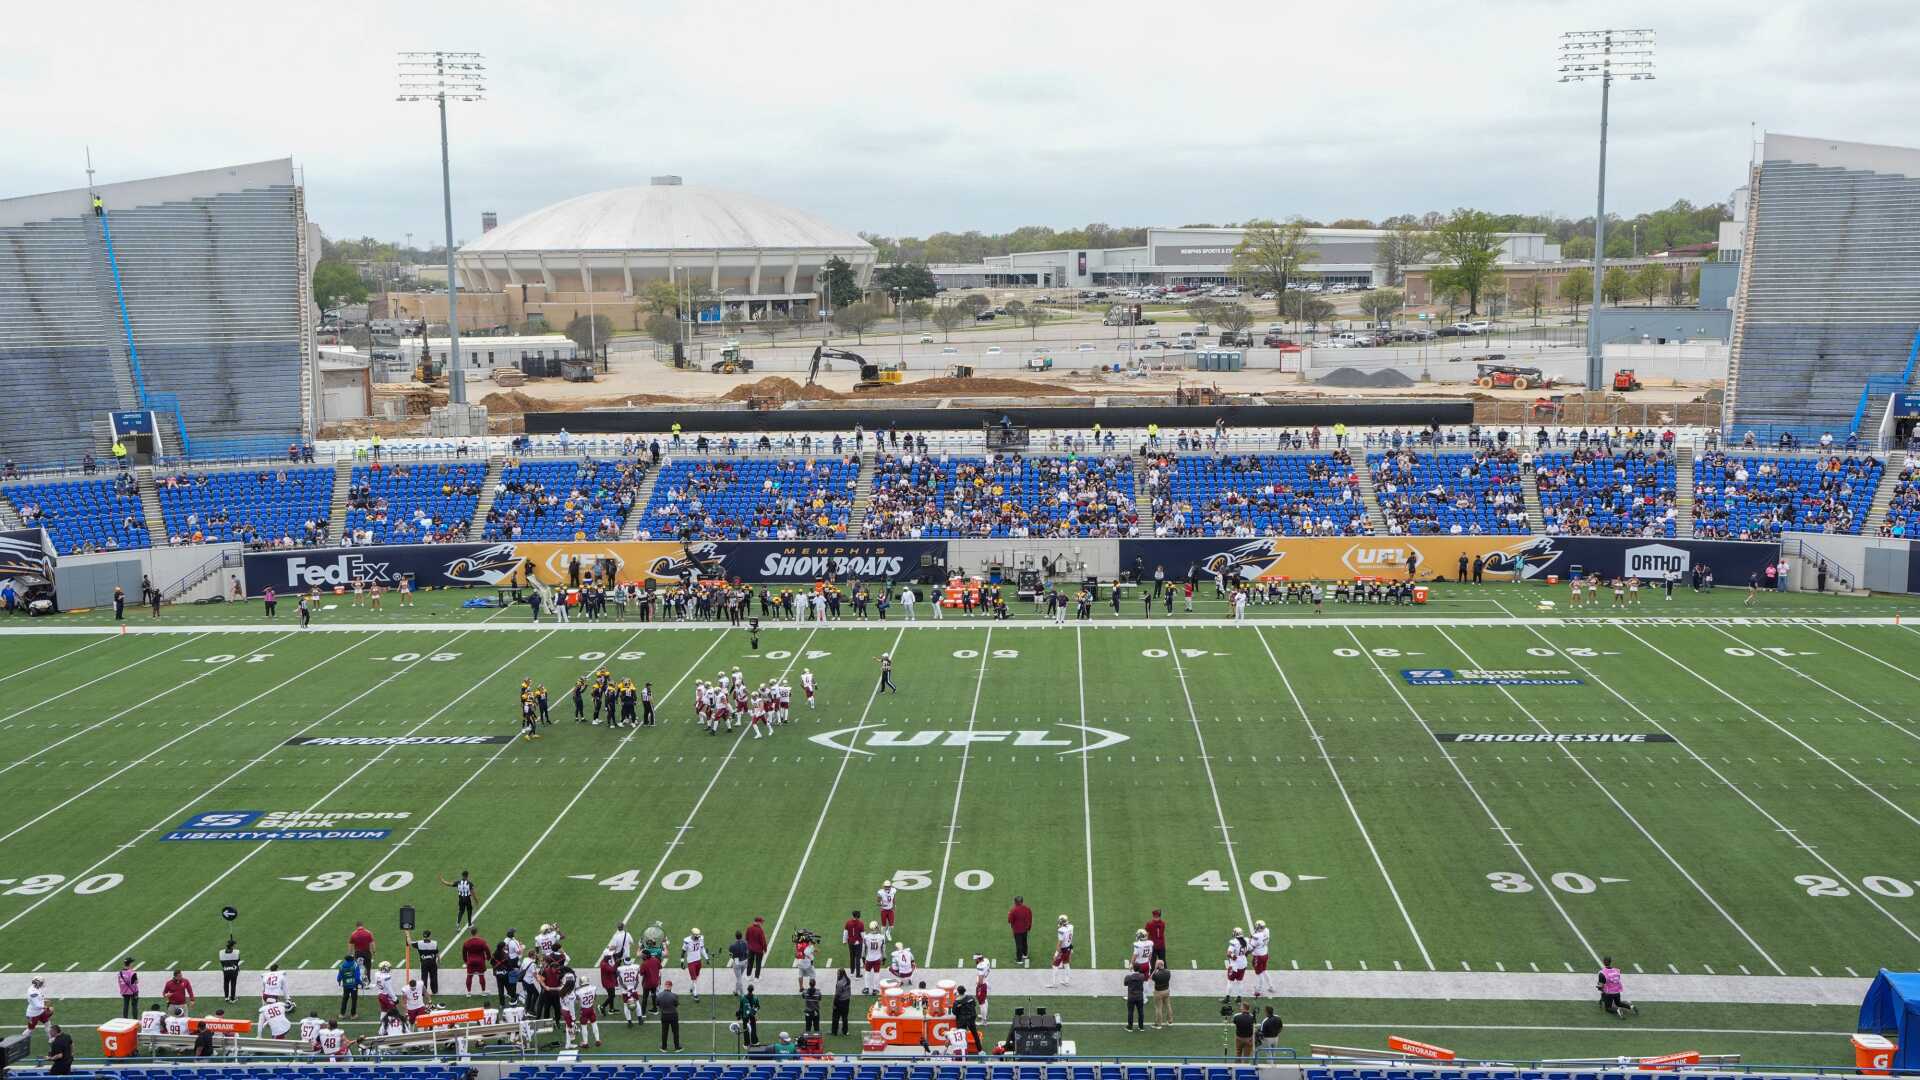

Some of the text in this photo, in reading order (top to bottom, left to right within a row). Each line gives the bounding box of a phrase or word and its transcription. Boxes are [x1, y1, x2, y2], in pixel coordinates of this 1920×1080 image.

[1357, 548, 1408, 564] UFL
[1631, 554, 1682, 571] ORTHO
[287, 554, 390, 587] FedEx
[865, 730, 1073, 746] UFL
[1455, 734, 1647, 742] PROGRESSIVE
[265, 810, 413, 821] Simmons
[254, 819, 339, 829] Bank
[167, 830, 385, 841] LIBERTY STADIUM
[2, 873, 125, 896] 20
[305, 871, 415, 893] 30
[598, 869, 704, 891] 40
[892, 869, 995, 891] 50
[1187, 869, 1292, 892] 40
[1485, 871, 1598, 895] 30
[1794, 873, 1915, 898] 20
[582, 995, 594, 1006] 22
[268, 1006, 281, 1019] 96
[432, 1013, 470, 1024] GATORADE
[880, 1022, 897, 1040] G
[105, 1035, 118, 1051] G
[324, 1037, 336, 1049] 48
[1402, 1043, 1439, 1058] GATORADE
[1873, 1053, 1889, 1070] G
